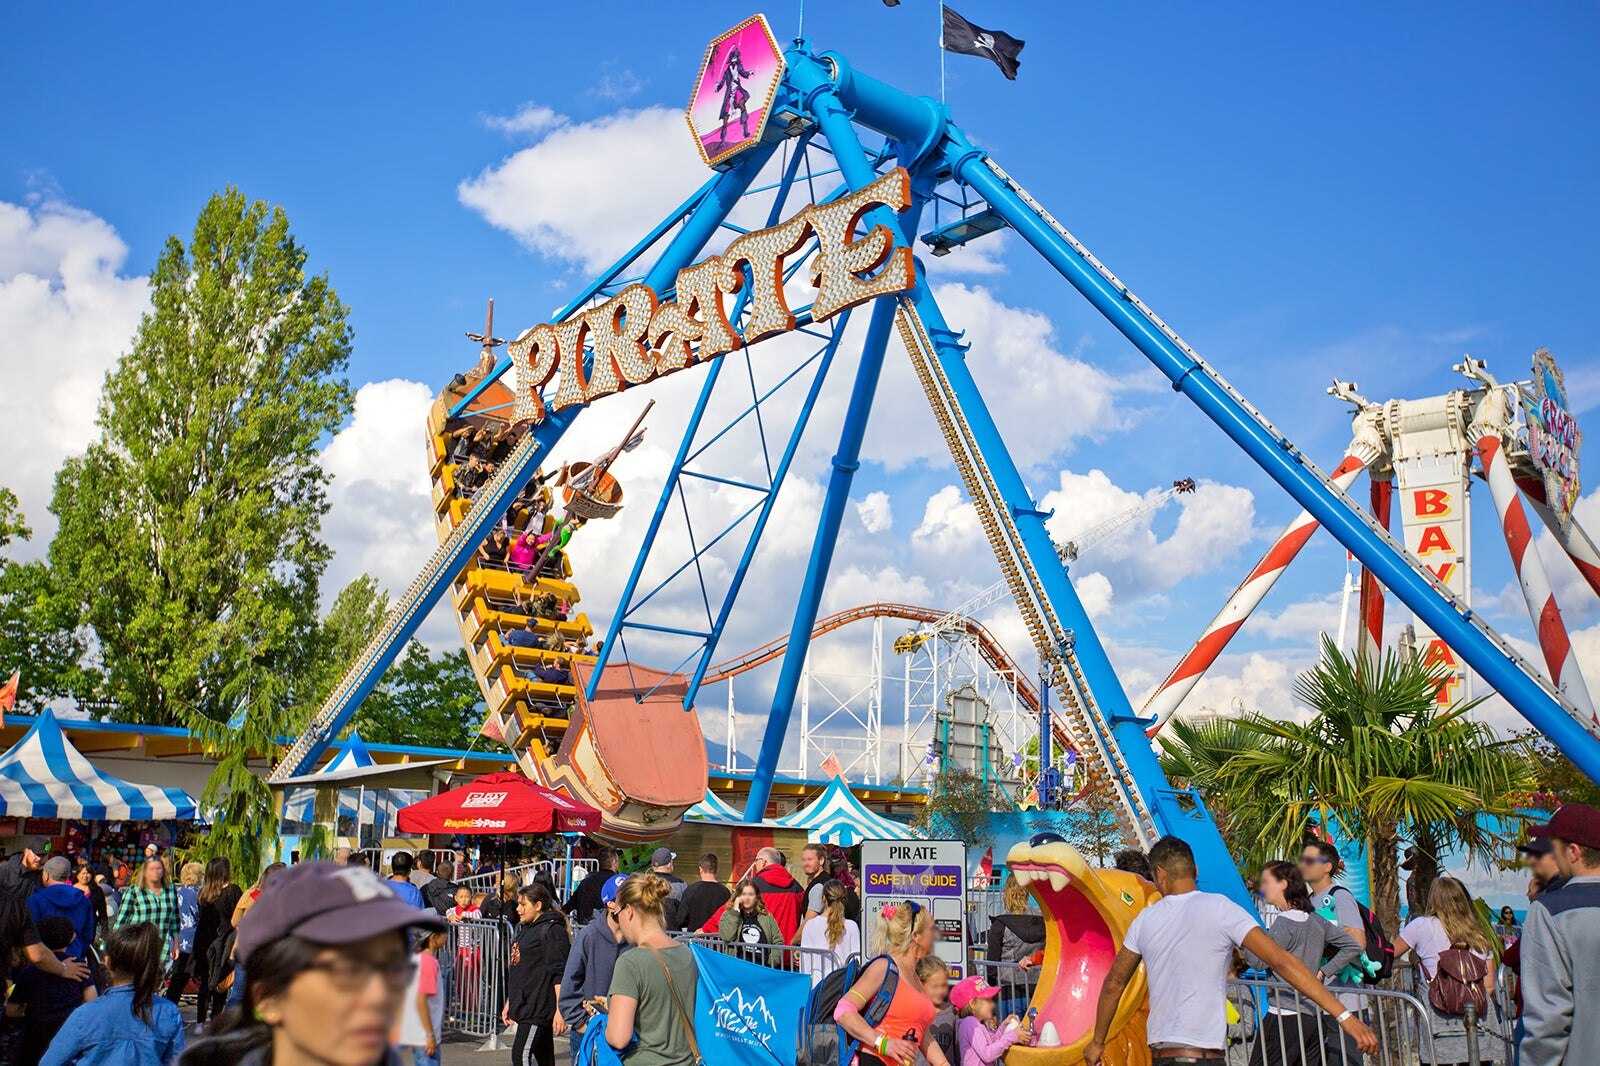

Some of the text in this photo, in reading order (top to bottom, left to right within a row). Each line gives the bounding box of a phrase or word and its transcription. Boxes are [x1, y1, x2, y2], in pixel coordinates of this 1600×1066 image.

[508, 167, 915, 428] PIRATE
[889, 846, 937, 860] PIRATE
[869, 873, 916, 887] SAFETY
[919, 874, 957, 887] GUIDE
